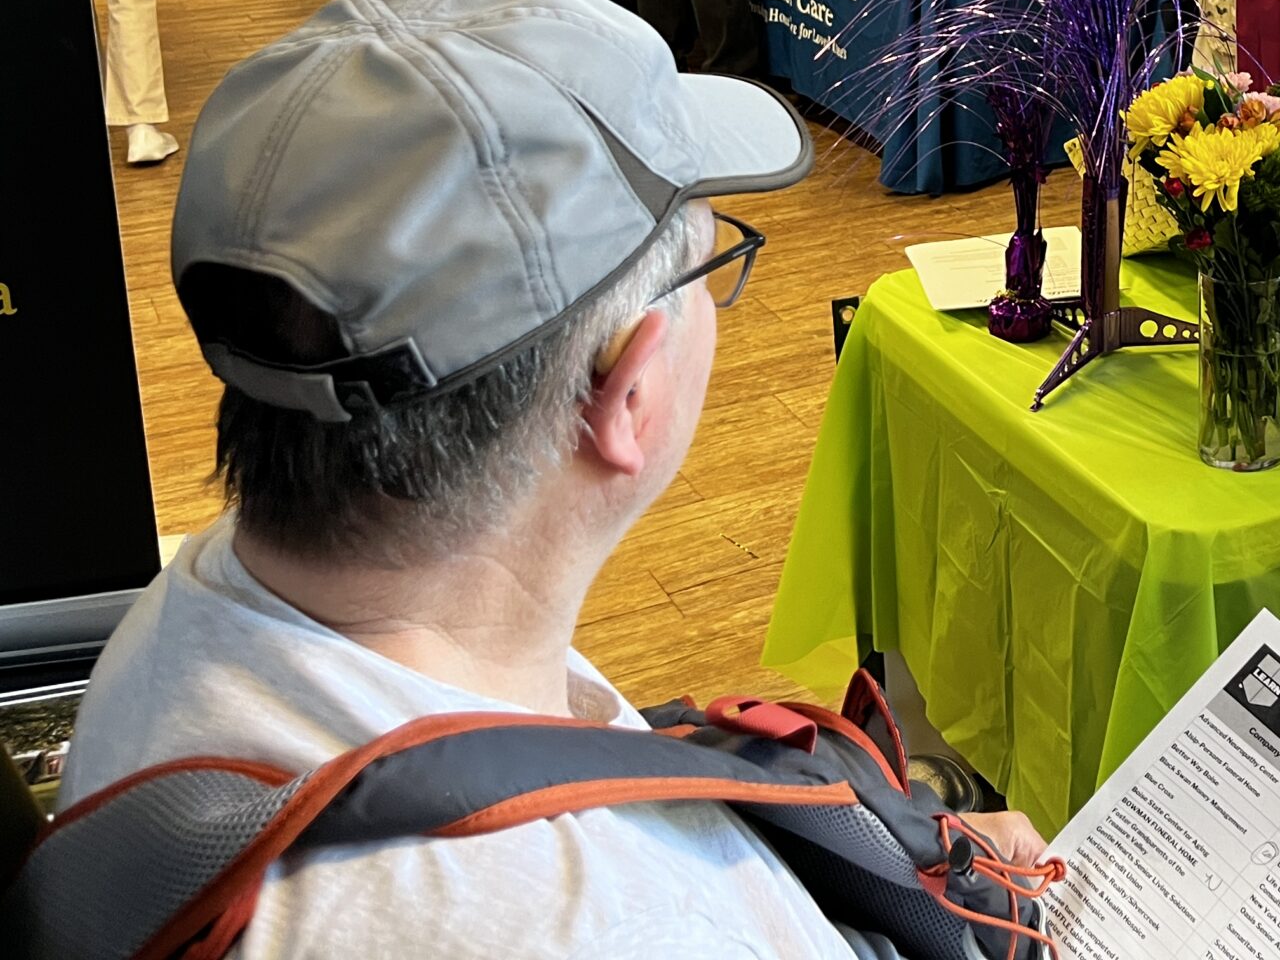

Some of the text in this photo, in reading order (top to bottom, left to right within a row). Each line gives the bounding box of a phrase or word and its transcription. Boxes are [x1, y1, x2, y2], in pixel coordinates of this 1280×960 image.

[1170, 742, 1220, 786] Better Way Boise
[1198, 712, 1279, 784] Advanced Neuropathy Center
[1143, 771, 1175, 800] Blue Cross
[1158, 755, 1248, 835] Black Swan Money Management
[1221, 761, 1245, 783] Funeral
[1242, 780, 1261, 798] Home
[1111, 807, 1187, 877] Foster Grandparents of the
[1120, 795, 1198, 866] BOWMAN FUNERAL HOME
[1130, 785, 1211, 858] Boise State Center for Aging
[1060, 875, 1085, 899] ystone
[1085, 835, 1145, 891] Horizon Credit Union
[1095, 824, 1199, 923] Gentle Hearts Senior Living Solutions
[1264, 874, 1279, 888] Life
[1045, 904, 1073, 930] RAFFLE
[1248, 894, 1264, 909] New
[1261, 906, 1279, 923] York
